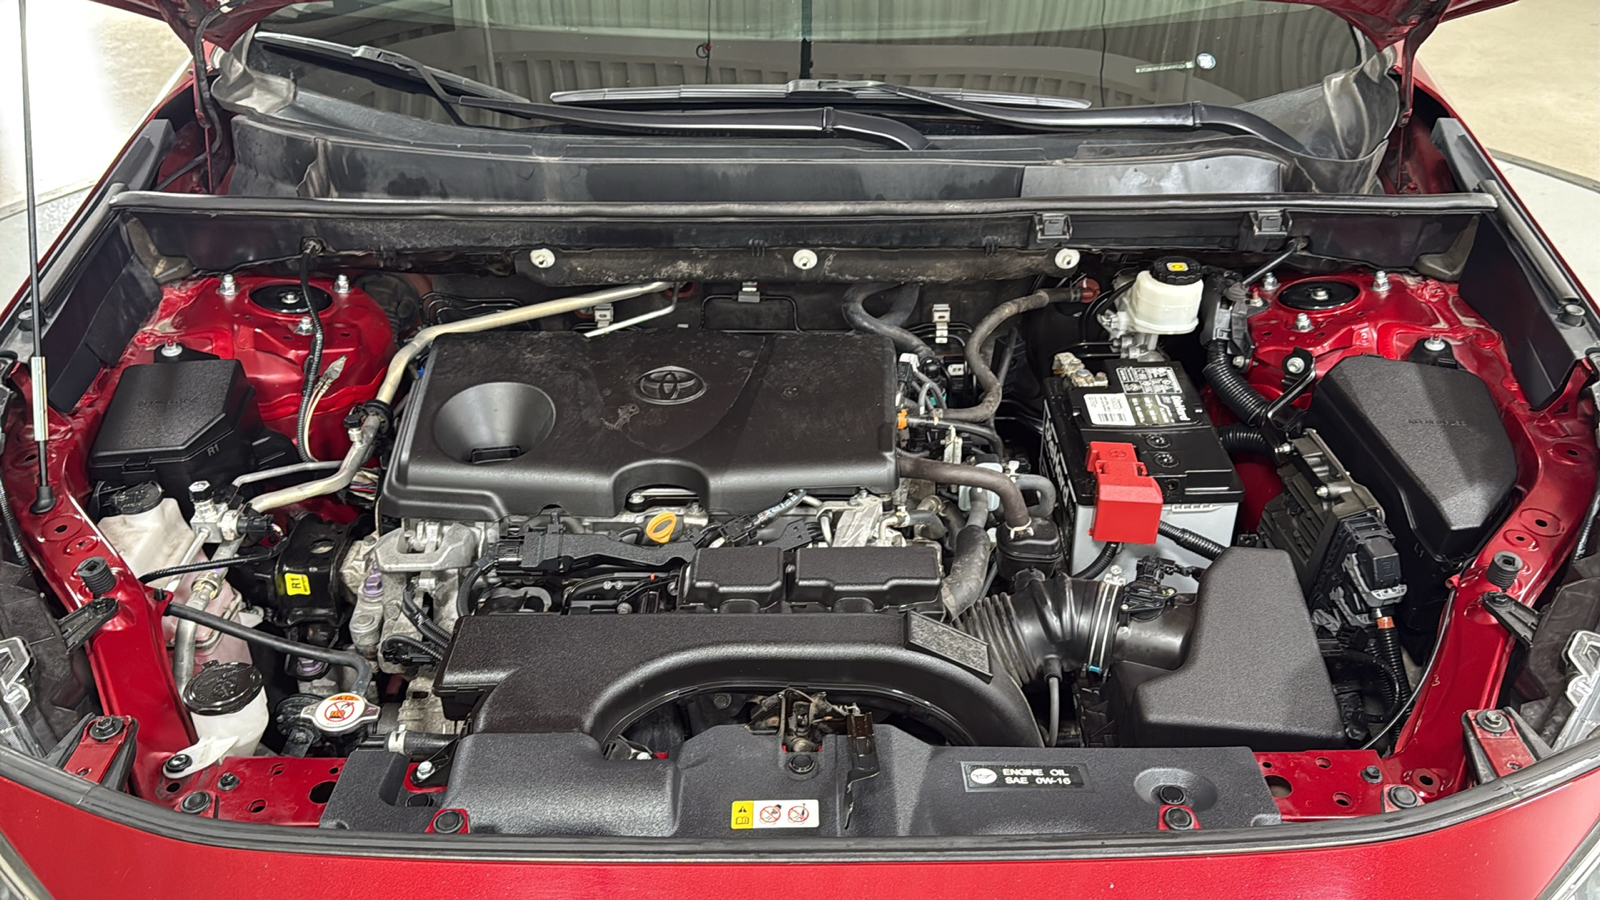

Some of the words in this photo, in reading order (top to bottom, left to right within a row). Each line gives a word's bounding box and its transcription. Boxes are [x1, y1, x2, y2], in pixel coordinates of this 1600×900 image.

[1002, 768, 1044, 776] ENGINE
[1049, 768, 1070, 776] OIL
[1004, 777, 1029, 785] SAE
[1035, 777, 1071, 785] 0W-16
